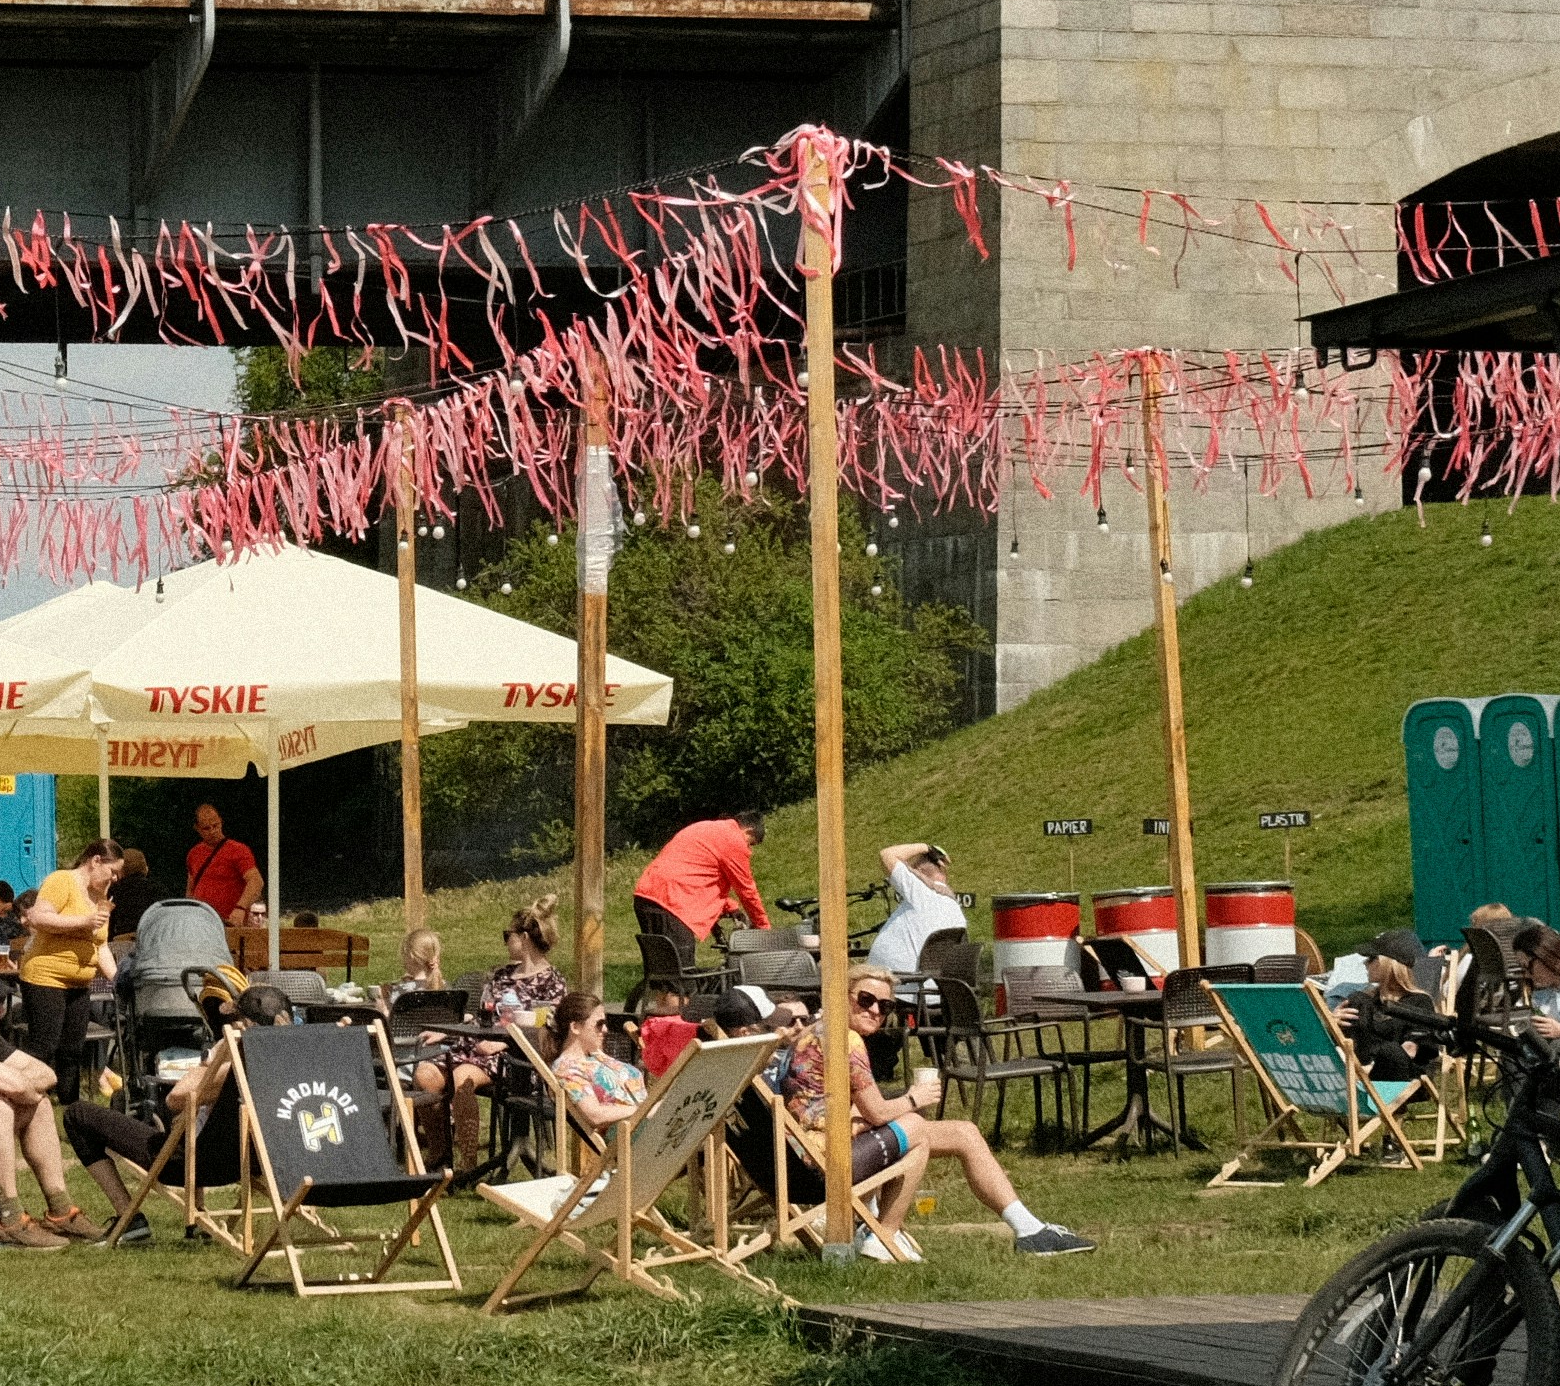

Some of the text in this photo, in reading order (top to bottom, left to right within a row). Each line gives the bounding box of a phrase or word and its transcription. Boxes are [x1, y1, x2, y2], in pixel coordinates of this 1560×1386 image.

[145, 685, 268, 715] TYSKIE
[502, 682, 621, 708] TYSKE
[1047, 820, 1089, 834] PAPIER
[1260, 813, 1307, 827] PLASTIK
[276, 1081, 359, 1120] HARDMADE
